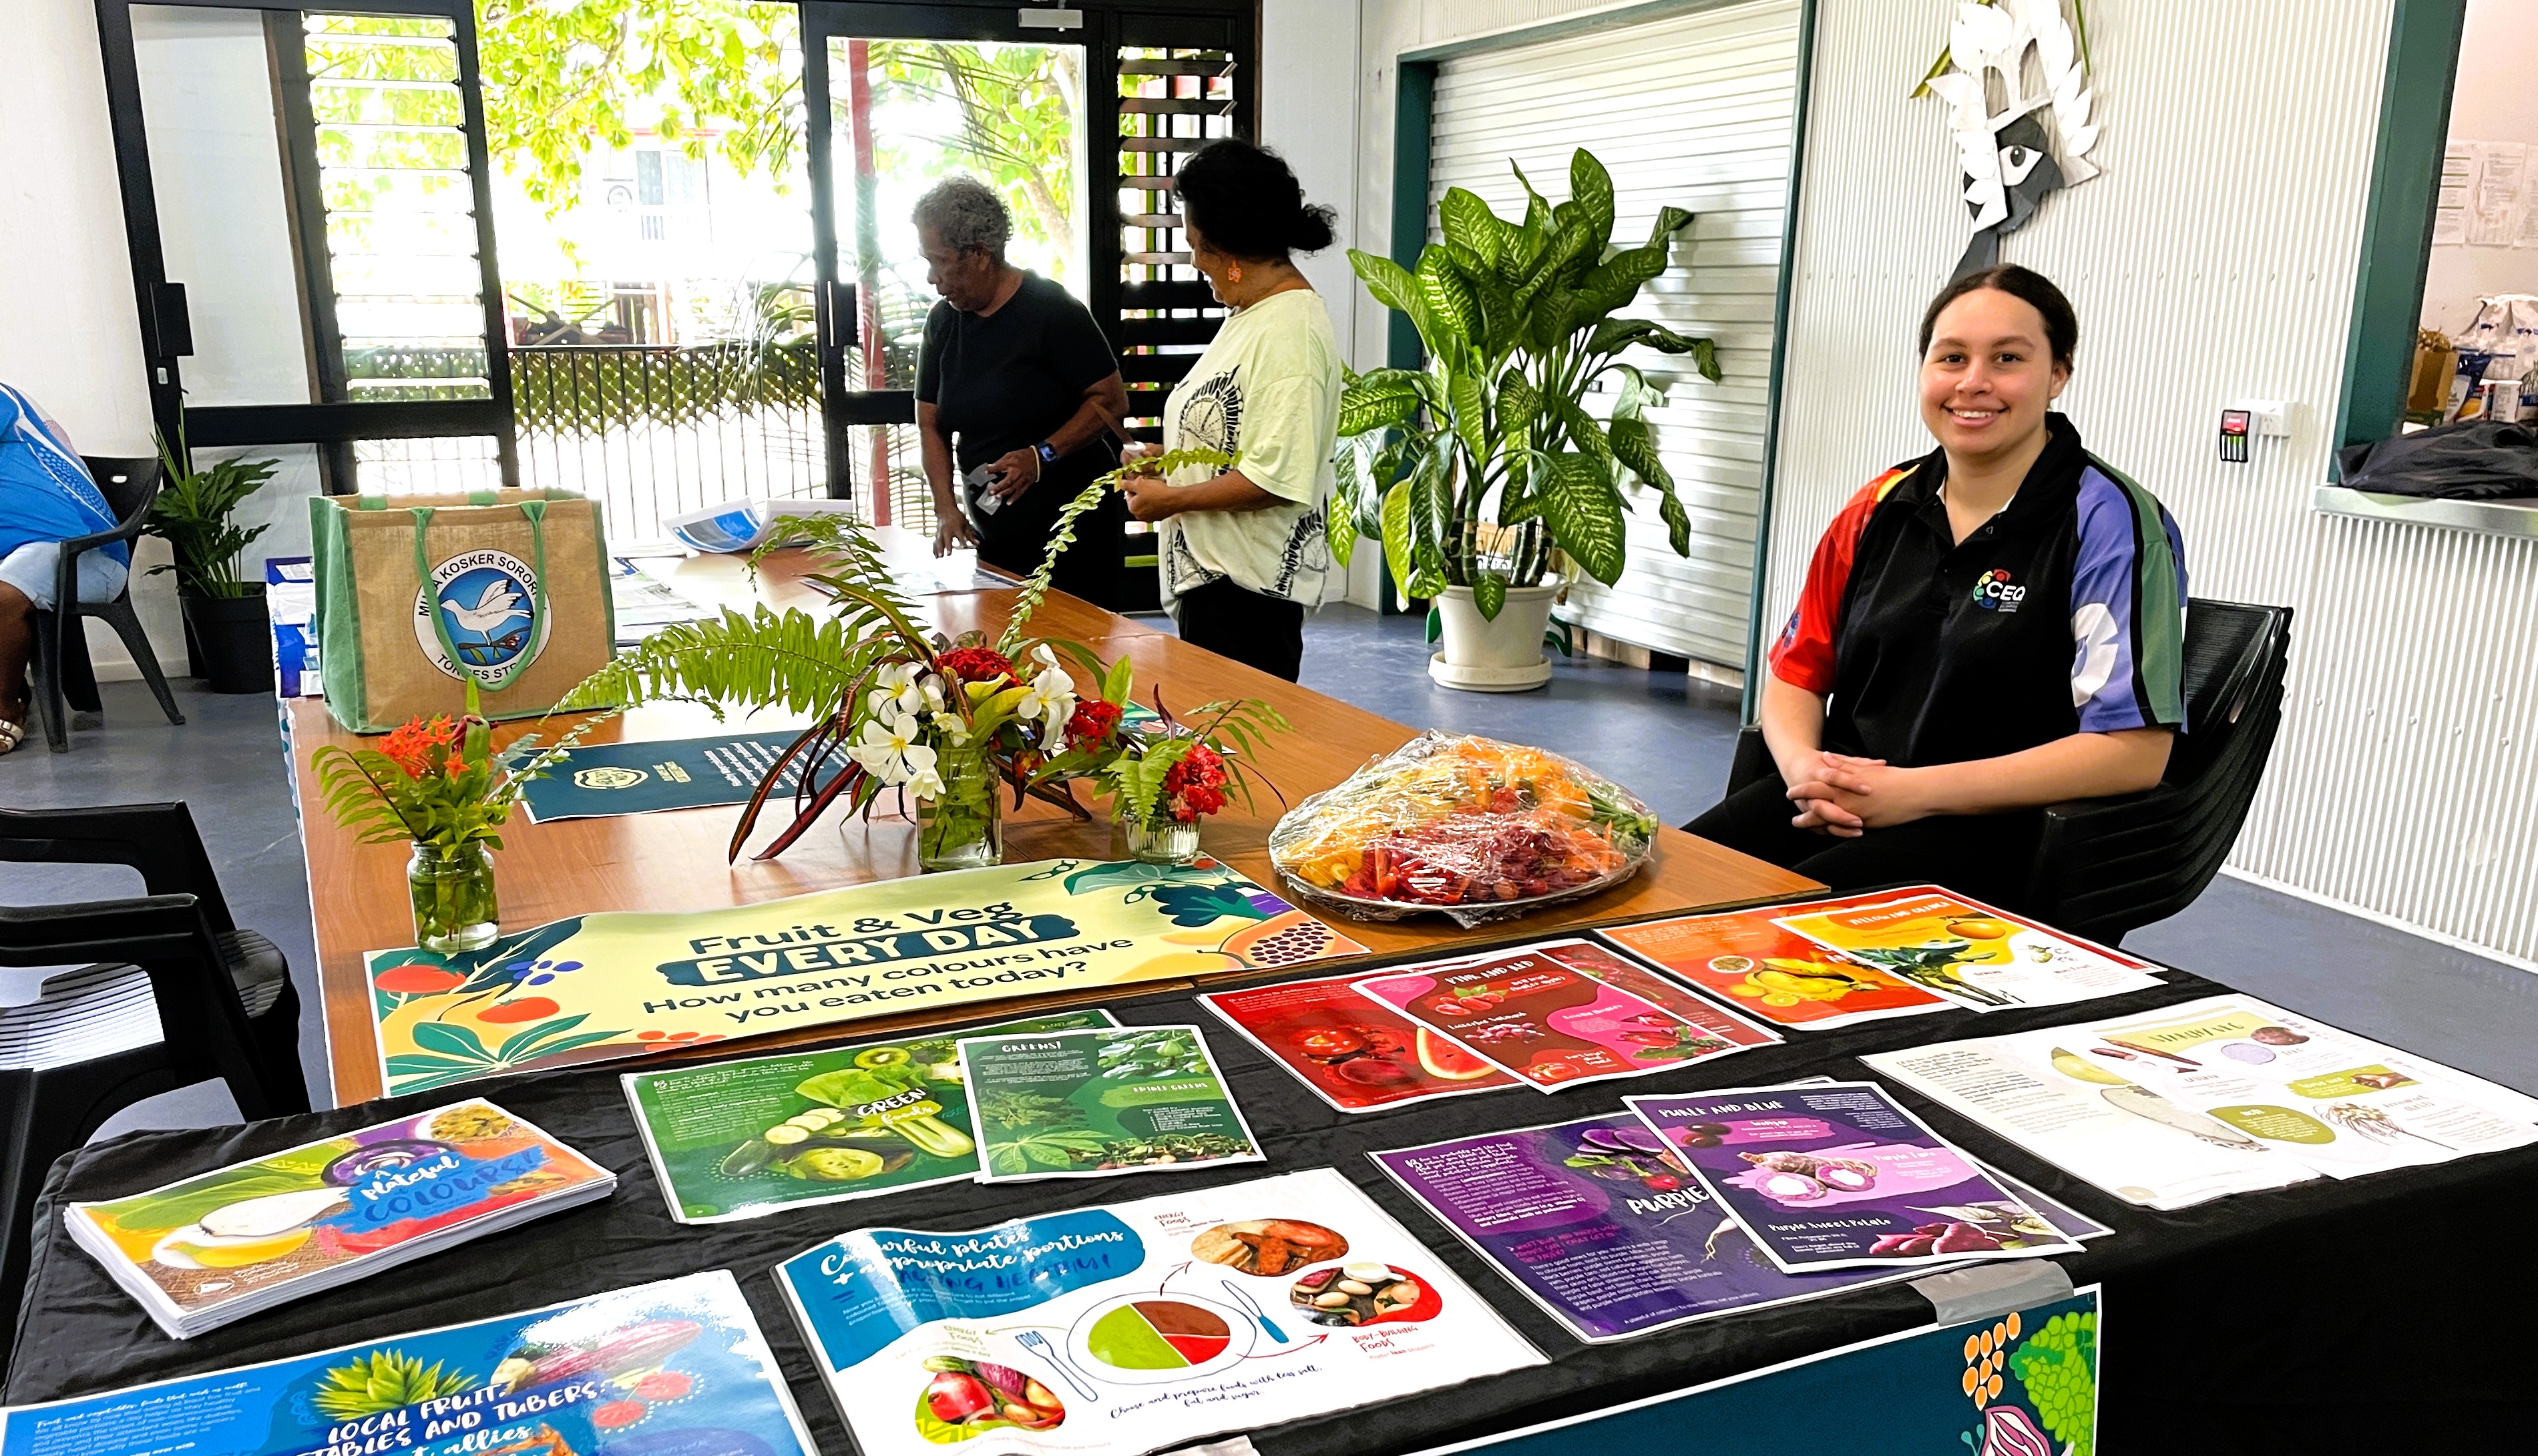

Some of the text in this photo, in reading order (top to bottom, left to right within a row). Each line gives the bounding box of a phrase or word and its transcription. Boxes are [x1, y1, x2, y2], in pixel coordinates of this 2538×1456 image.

[439, 554, 494, 579] KOSKER
[1986, 581, 2026, 601] CEQ
[688, 901, 1025, 955] Fruit & Veg
[696, 918, 1039, 982] EVERY DAY
[644, 939, 1134, 1014] How many colours have
[725, 961, 1088, 1023] you eaten today?
[1002, 1041, 1062, 1052] GREENS!
[857, 1087, 926, 1116] GREEN
[881, 1106, 933, 1125] foods
[1710, 1103, 1741, 1115] AND
[1745, 1100, 1786, 1112] BLUE
[365, 1150, 534, 1222] COLOURS!
[1627, 1186, 1709, 1215] PURPLE
[1768, 1218, 1892, 1232] Purple Sweet Potato
[951, 1232, 1030, 1257] plates
[1023, 1231, 1124, 1262] portions
[1359, 1338, 1395, 1353] FOODS
[1110, 1401, 1145, 1419] Choose
[1148, 1391, 1171, 1405] and
[1173, 1387, 1217, 1401] prepare
[1220, 1381, 1247, 1392] foods
[1250, 1374, 1275, 1385] with
[1276, 1371, 1295, 1379] less
[1184, 1396, 1204, 1407] fat
[1207, 1393, 1229, 1402] and
[425, 1411, 481, 1440] AND
[493, 1381, 598, 1421] TUBERS
[328, 1409, 410, 1444] LOCAL
[443, 1425, 533, 1455] allies
